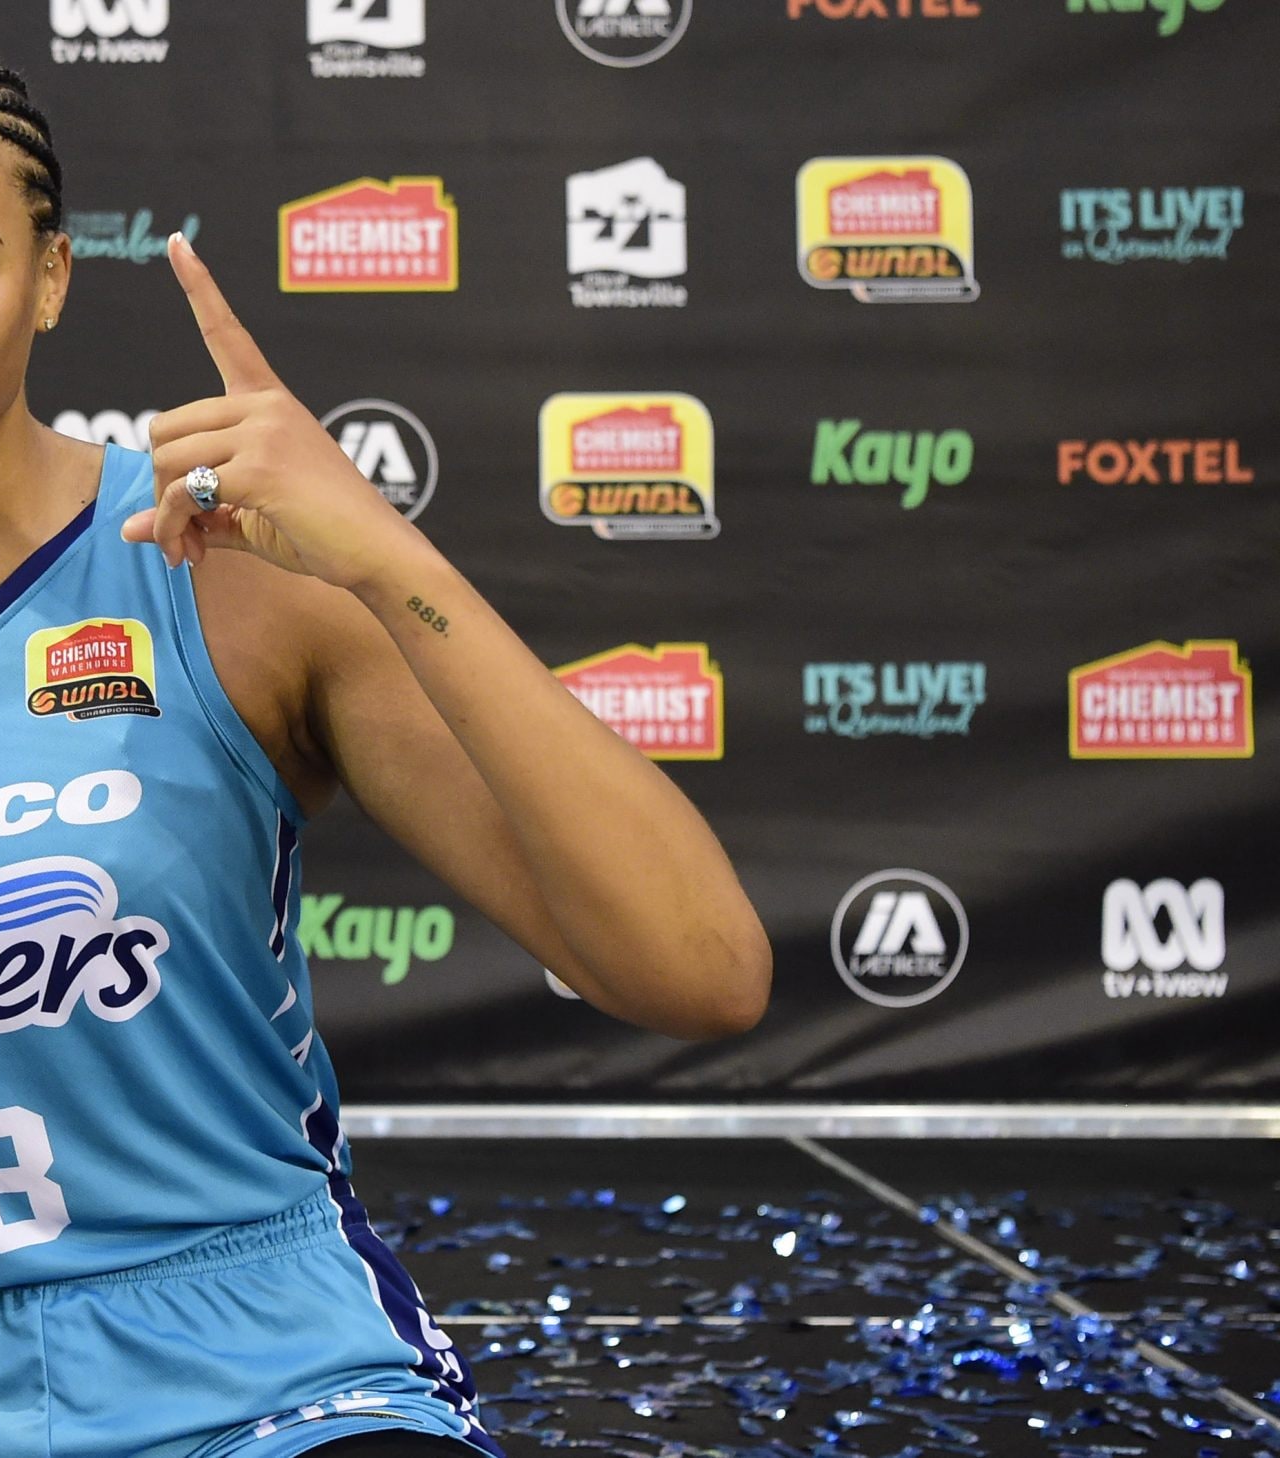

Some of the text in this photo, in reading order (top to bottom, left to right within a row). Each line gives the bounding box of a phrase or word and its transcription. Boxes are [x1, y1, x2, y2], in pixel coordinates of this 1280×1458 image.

[310, 53, 425, 77] Townsville
[831, 192, 936, 217] CHEMIST
[1060, 186, 1244, 231] IT'S LIVE!
[292, 217, 445, 254] CHEMIST
[571, 282, 688, 308] Townsville
[574, 428, 678, 451] CHEMIST
[811, 419, 973, 509] Kayo
[1057, 440, 1253, 484] FOXTEL
[51, 641, 127, 666] CHEMIST
[51, 659, 127, 677] WAREHOUSE
[61, 681, 147, 706] WNBL
[804, 662, 986, 705] IT'S LIVE!
[80, 708, 150, 718] CHAMPIONSHIP
[1082, 682, 1240, 720] CHEMIST
[297, 893, 454, 985] Kayo
